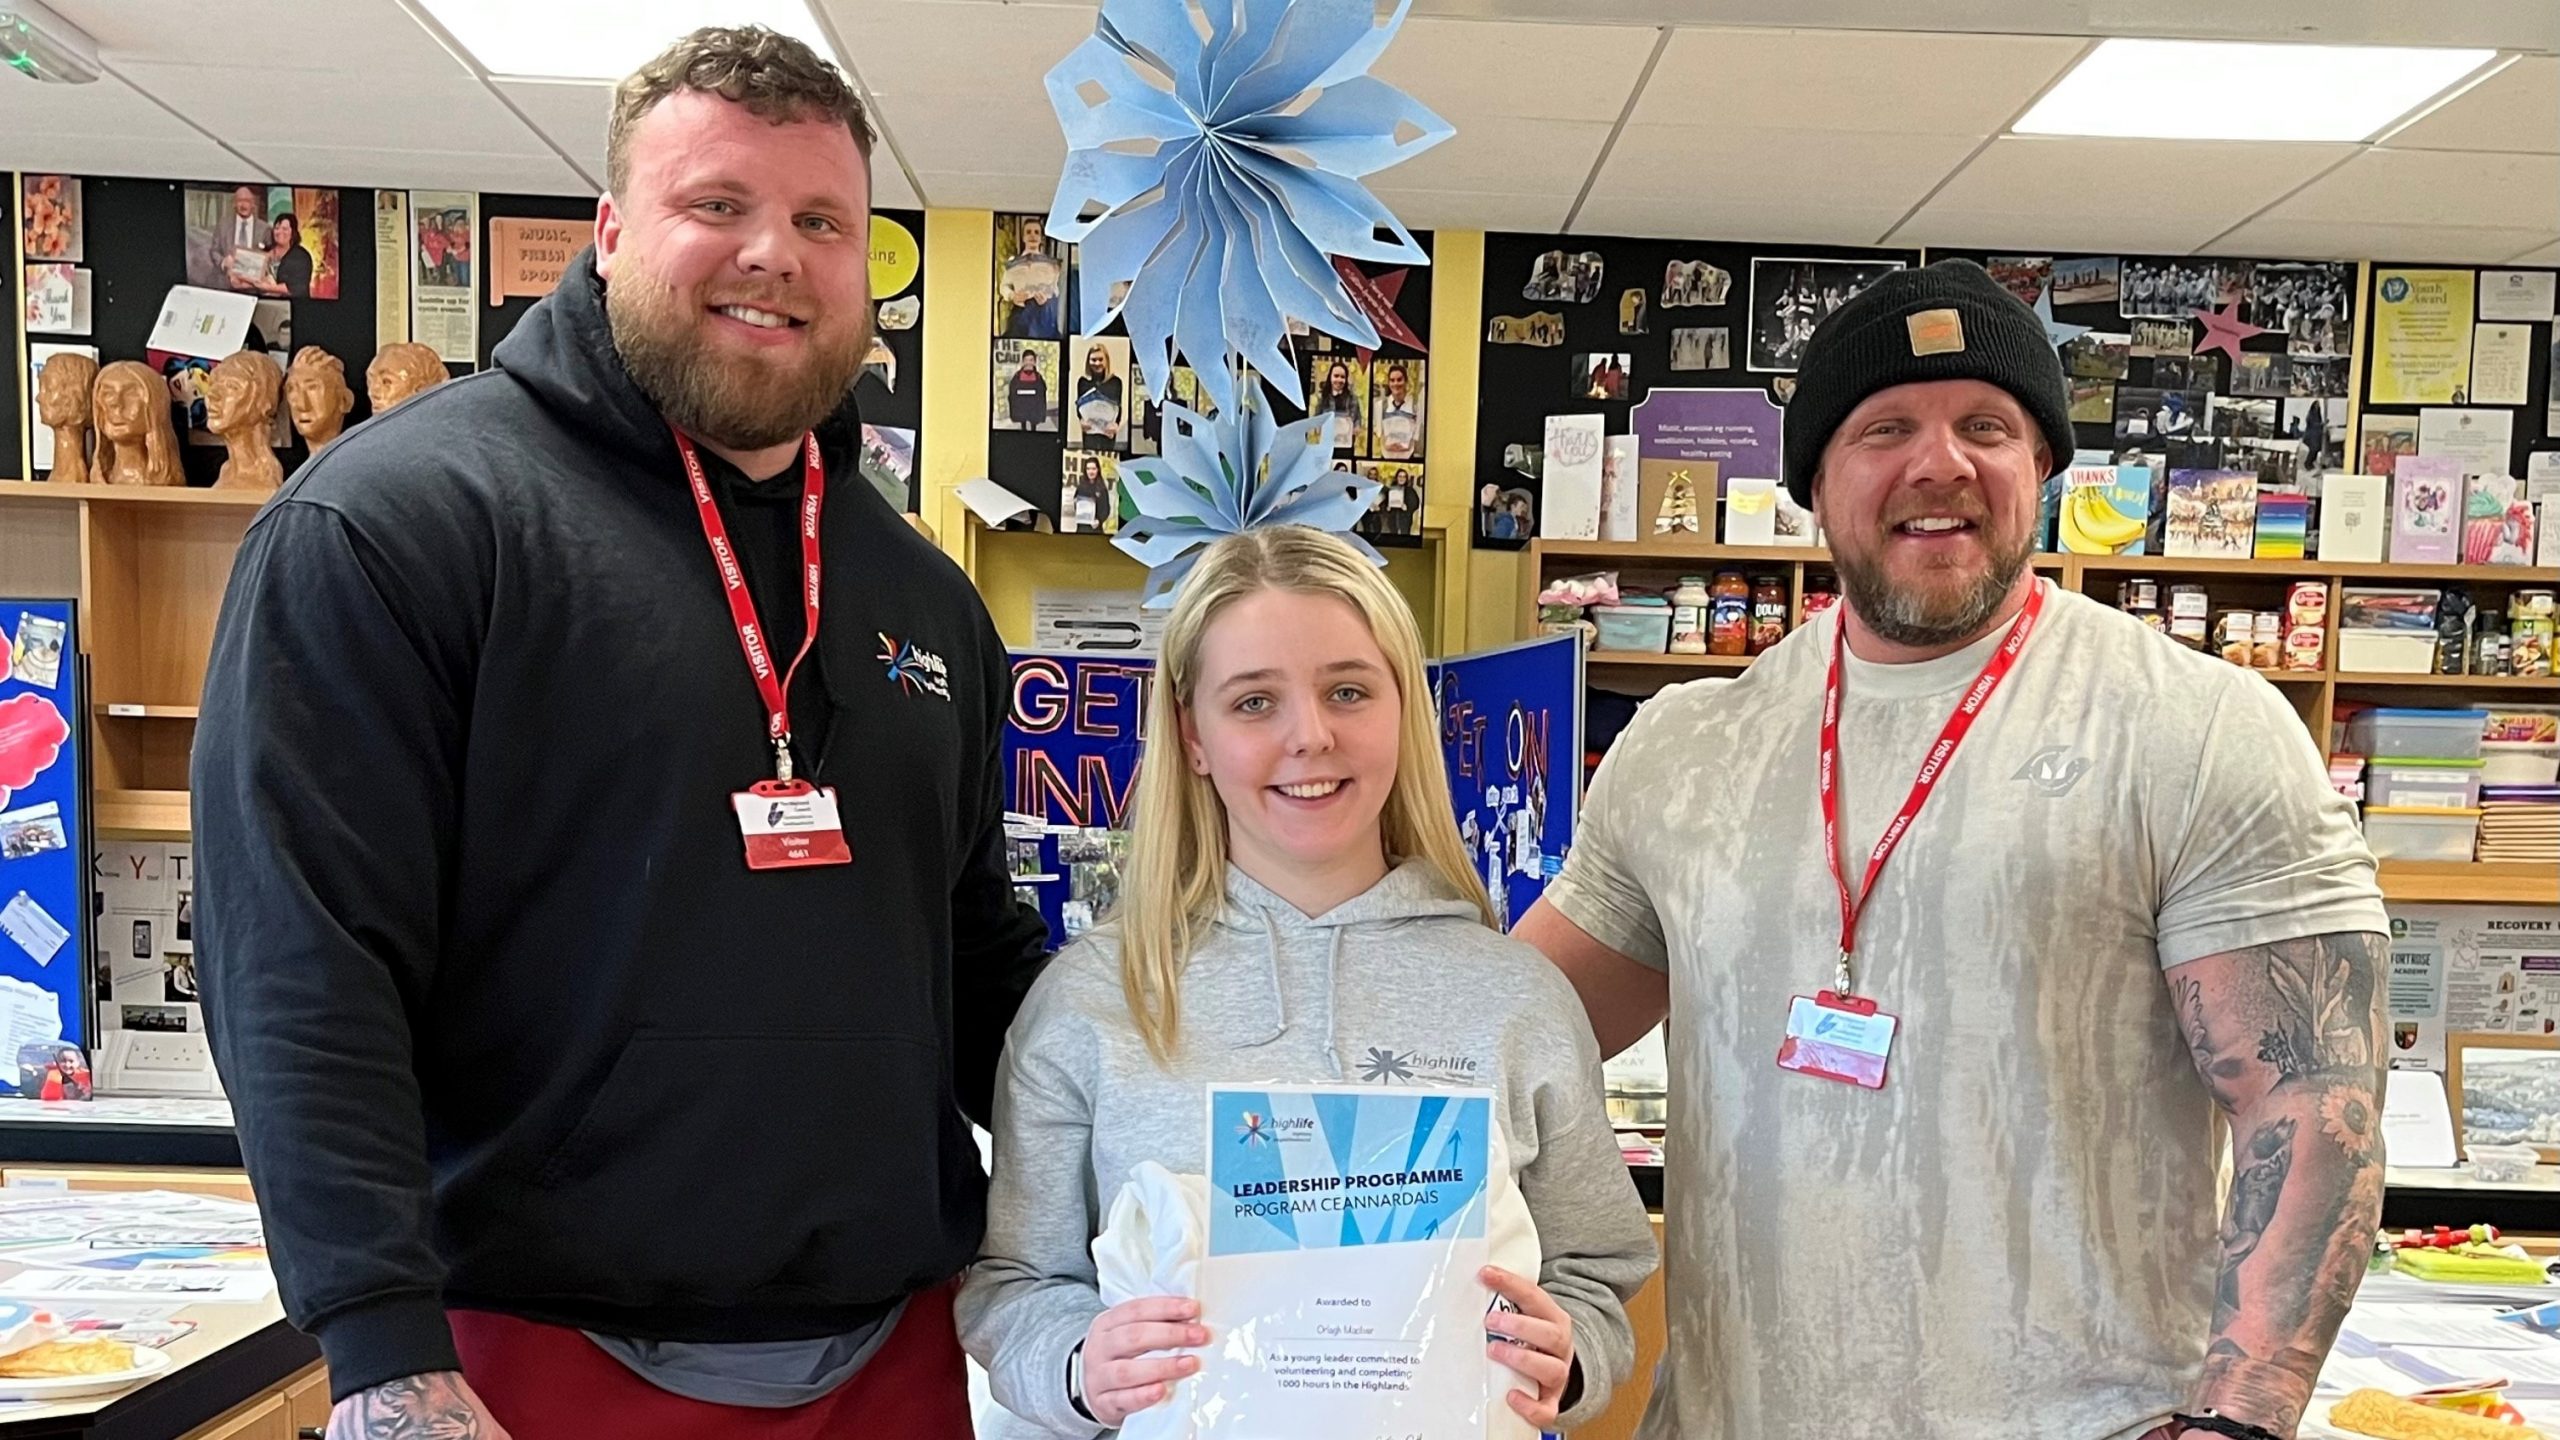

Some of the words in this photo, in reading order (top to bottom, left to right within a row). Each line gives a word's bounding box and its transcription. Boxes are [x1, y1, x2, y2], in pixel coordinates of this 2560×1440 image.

[519, 227, 572, 244] MUSIC,
[519, 248, 566, 262] FRESH
[685, 449, 711, 504] VISITOR
[2070, 468, 2116, 486] THANKS
[805, 493, 819, 539] VISITOR
[712, 535, 741, 590] VISITOR
[742, 623, 770, 680] VISITOR
[1008, 658, 1156, 740] GET
[1961, 673, 1996, 715] VISITOR
[1442, 670, 1487, 793] GET
[1507, 700, 1549, 798] ON
[1917, 739, 1955, 785] VISITOR
[1872, 815, 1911, 861] VISITOR
[129, 854, 147, 880] Y
[169, 855, 188, 880] T
[2487, 920, 2552, 930] RECOVERY
[2391, 952, 2431, 966] FORTROSE
[2394, 967, 2428, 975] ACADEMY
[1412, 1054, 1477, 1071] highlife
[1270, 1116, 1315, 1132] highlife
[1233, 1176, 1341, 1198] LEADERSHIP
[1345, 1168, 1464, 1190] PROGRAMME
[1320, 1189, 1440, 1212] CEANNARDAIS
[1315, 1297, 1359, 1307] Awarded
[1361, 1298, 1371, 1308] to
[1269, 1353, 1281, 1362] As
[1283, 1354, 1289, 1362] a
[1290, 1355, 1321, 1364] young
[1324, 1353, 1354, 1363] leader
[1355, 1354, 1408, 1365] committed
[1410, 1355, 1420, 1365] to
[1274, 1366, 1336, 1377] volunteering
[1338, 1367, 1356, 1376] and
[1358, 1367, 1413, 1380] completing
[1277, 1378, 1301, 1389] 1000
[1302, 1379, 1330, 1389] hours
[1332, 1379, 1341, 1389] in
[1343, 1379, 1359, 1389] the
